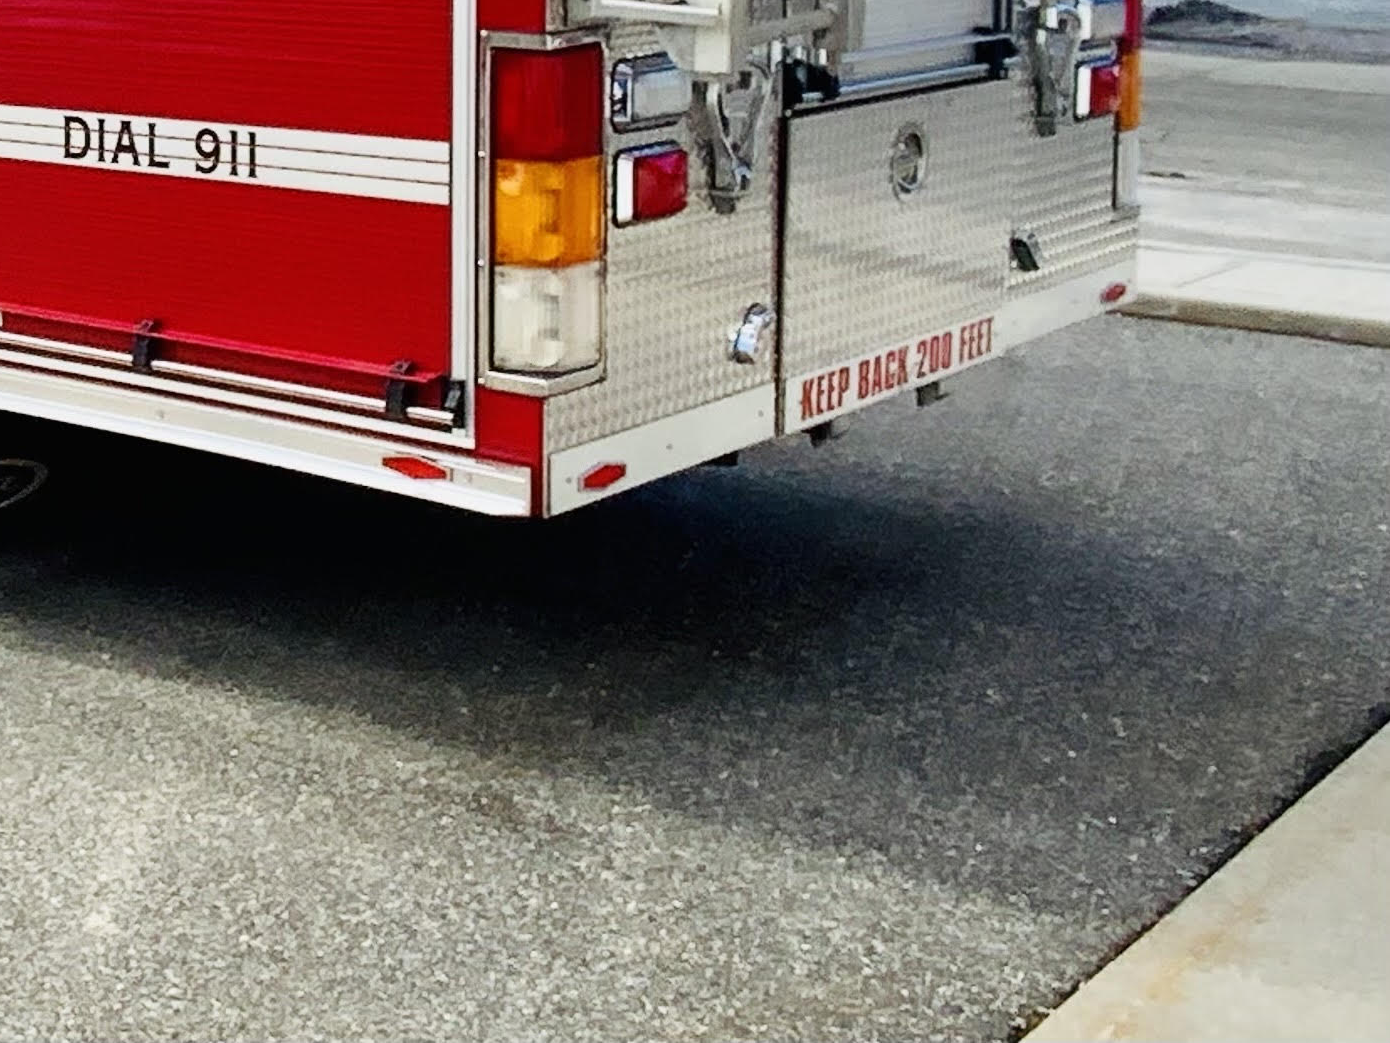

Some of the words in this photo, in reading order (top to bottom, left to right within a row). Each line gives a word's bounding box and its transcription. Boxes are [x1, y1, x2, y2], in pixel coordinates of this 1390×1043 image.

[63, 115, 171, 169] DIAL
[195, 127, 258, 179] 911
[800, 366, 850, 421] KEEP
[857, 345, 909, 400] BACK
[916, 331, 953, 379] 200
[959, 316, 994, 364] FEET
